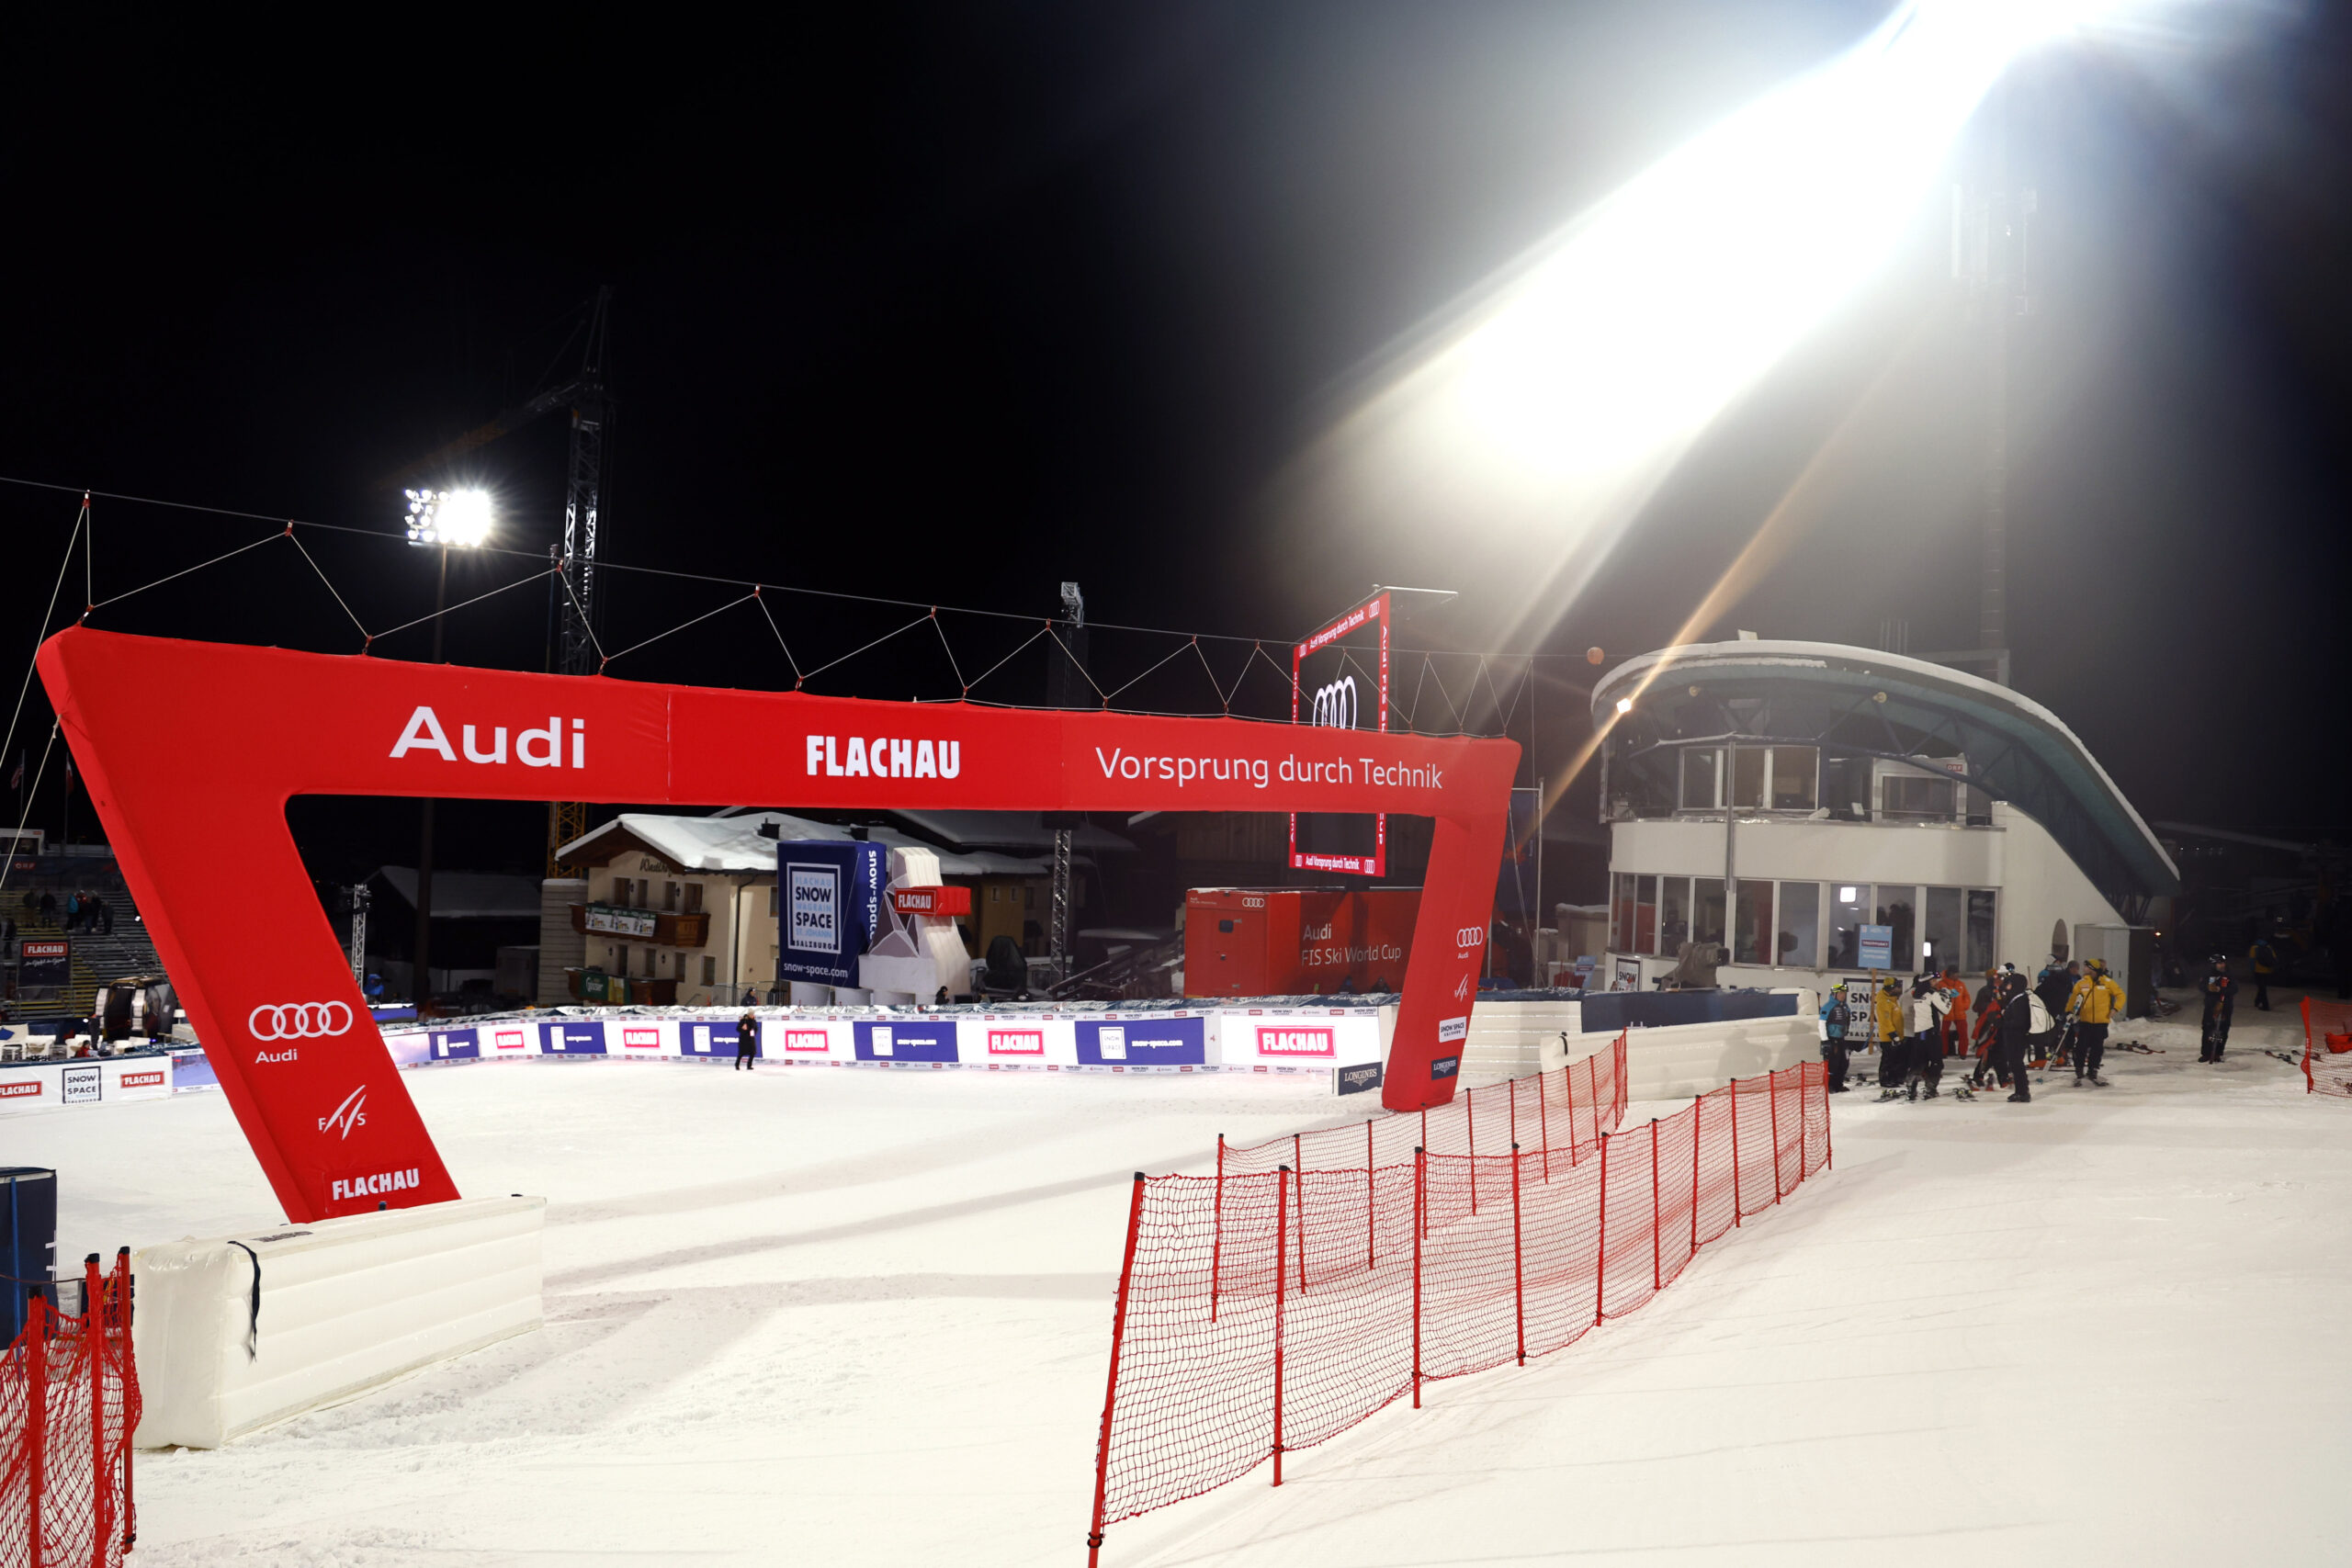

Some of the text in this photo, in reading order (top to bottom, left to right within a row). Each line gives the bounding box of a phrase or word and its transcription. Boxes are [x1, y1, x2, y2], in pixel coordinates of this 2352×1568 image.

[389, 705, 584, 769] Audi
[807, 735, 959, 779] FLACHAU
[1095, 747, 1442, 789] Vorsprung durch Technik
[1314, 856, 1332, 871] Vorsprung
[796, 886, 831, 902] SNOW
[899, 895, 932, 908] FLACHAU
[796, 912, 831, 929] SPACE
[1303, 923, 1331, 942] Audi
[28, 945, 63, 953] FLACHAU
[796, 940, 832, 950] SALZBURG
[1302, 944, 1401, 966] FIS Ski World Cup
[784, 963, 848, 977] snow-space.com
[1441, 1021, 1464, 1033] SNOW SPACE
[787, 1033, 826, 1049] FLACHAU
[991, 1034, 1039, 1051] FLACHAU
[1262, 1032, 1329, 1052] FLACHAU
[255, 1048, 298, 1064] Audi
[67, 1075, 96, 1084] SNOW
[124, 1074, 161, 1086] FLACHAU
[1344, 1068, 1377, 1082] LONGINES
[67, 1086, 96, 1095] SPACE
[332, 1168, 420, 1201] FLACHAU
